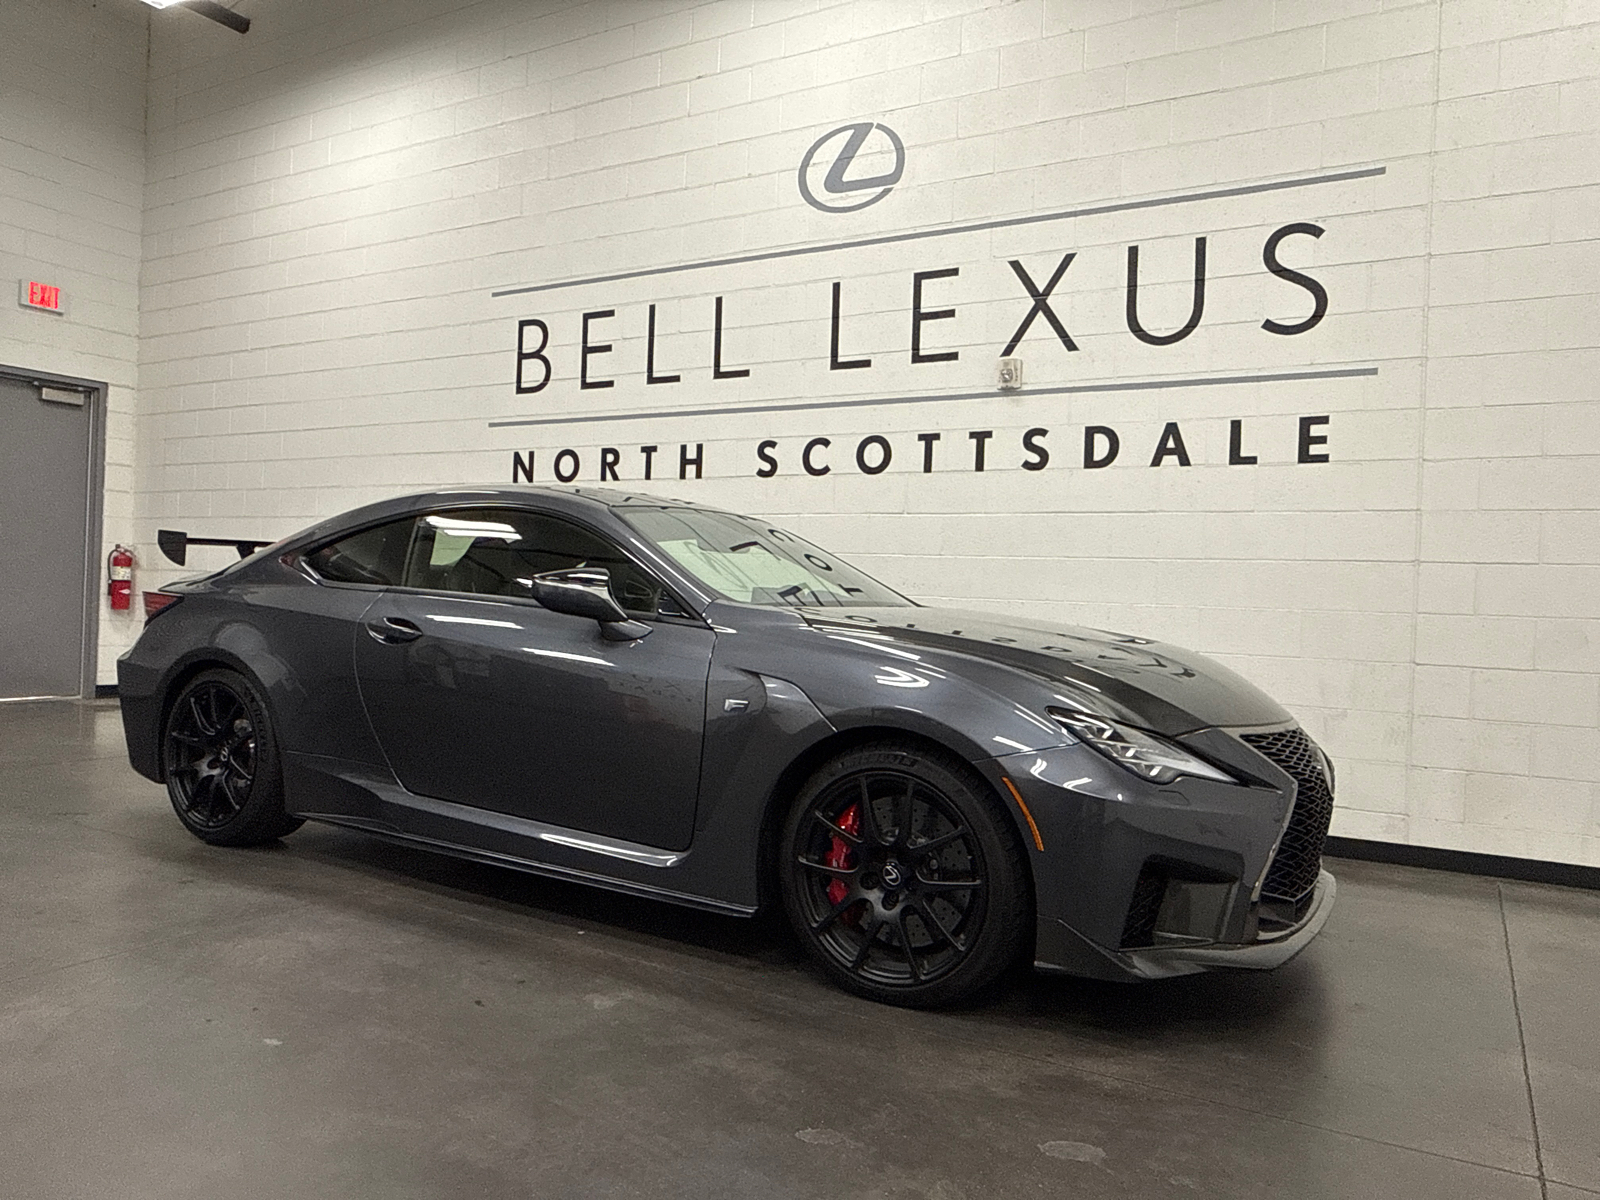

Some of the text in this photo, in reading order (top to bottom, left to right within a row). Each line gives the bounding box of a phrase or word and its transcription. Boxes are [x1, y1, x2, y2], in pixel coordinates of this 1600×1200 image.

[29, 281, 60, 309] EXIT
[515, 222, 1328, 395] BELL LEXUS
[512, 415, 1330, 484] NORTH SCOTTSDALE
